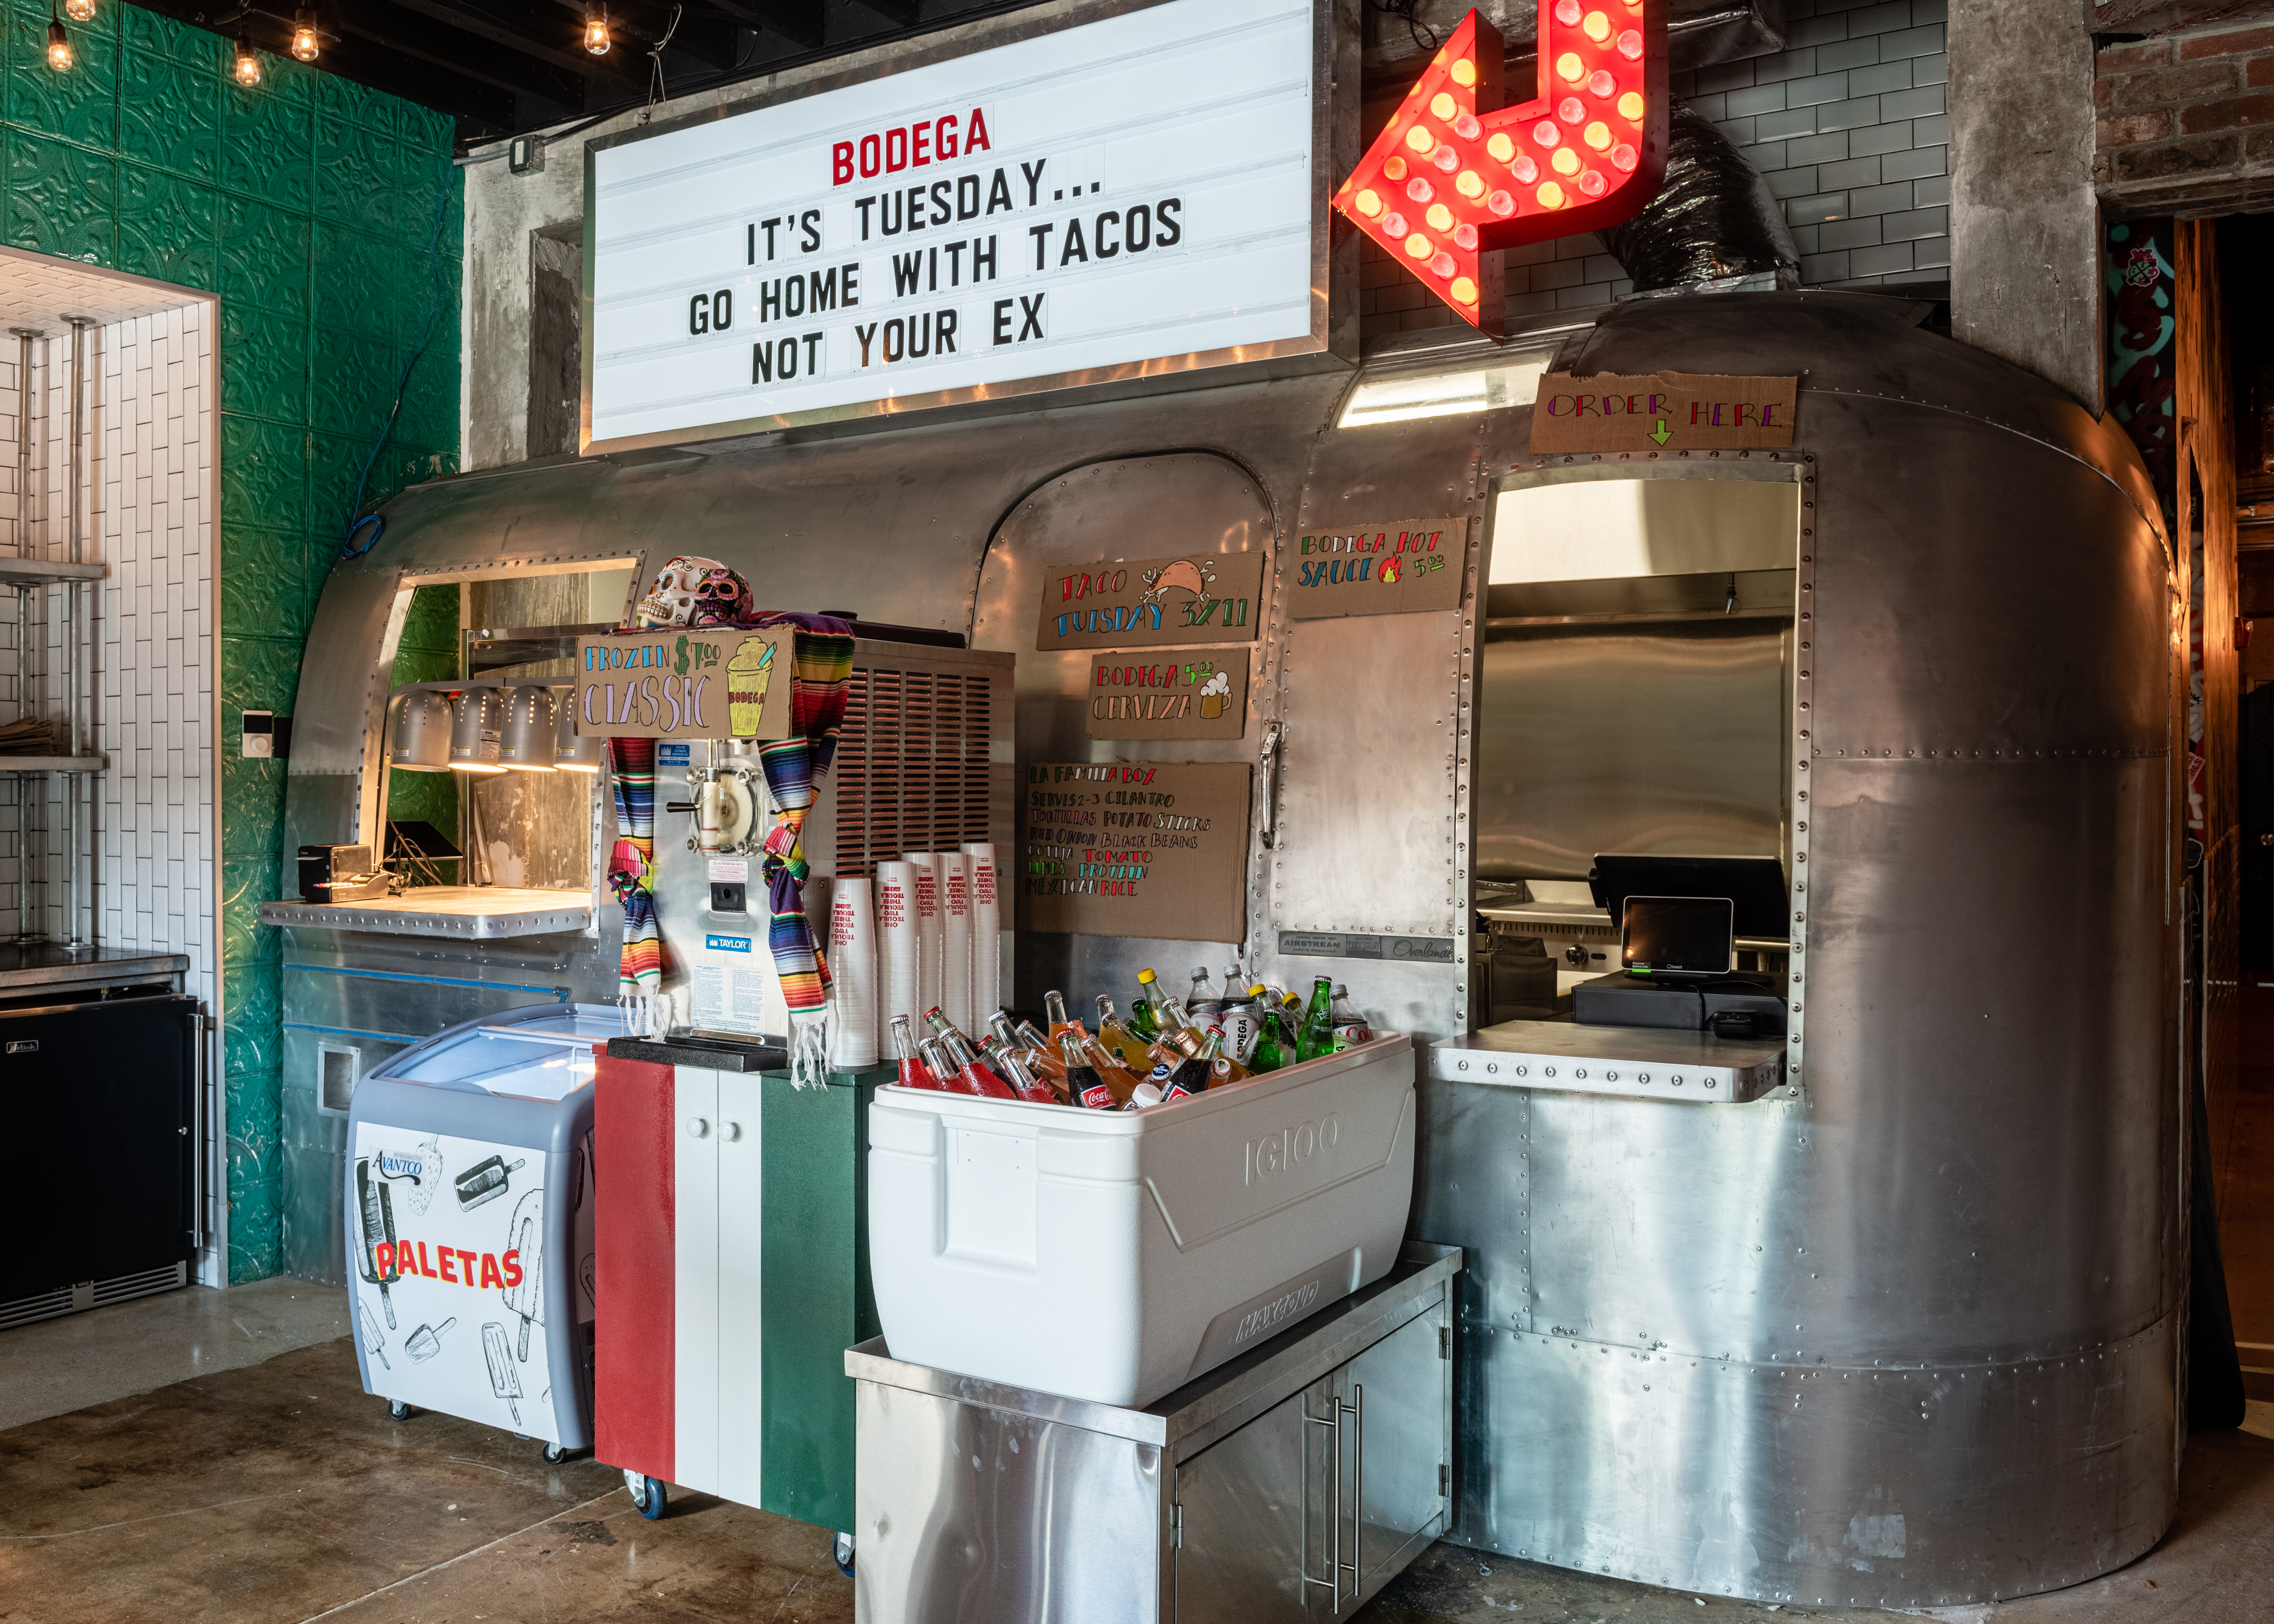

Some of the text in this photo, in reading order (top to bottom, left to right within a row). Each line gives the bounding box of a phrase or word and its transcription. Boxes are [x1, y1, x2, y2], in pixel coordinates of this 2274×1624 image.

[832, 107, 991, 186] BODEGA
[747, 158, 1101, 266] IT'S TUESDAY...
[690, 197, 1182, 336] GO HOME WITH TACOS
[752, 292, 1045, 385] NOT YOUR EX
[1548, 393, 1781, 428] ORDER HERE
[1301, 531, 1443, 554] BODEGA HOT
[1298, 558, 1373, 587] SAUCE
[1057, 570, 1127, 601] TACO
[1052, 603, 1167, 637] TUESDAY
[585, 645, 669, 671] FROZEN
[1097, 665, 1179, 688] BODEGA
[585, 675, 710, 732] CLASSIC
[729, 692, 764, 704] BODEGA
[1093, 694, 1191, 720] CERVEZA
[1030, 766, 1156, 785] LA FAMILIA BOX
[1031, 791, 1174, 807] SERVES 2-3 CILANTRO
[1031, 809, 1211, 831] TORTILLAS POTATO STICKS
[1030, 827, 1197, 849] RED ONION BLACK BEANS
[1028, 844, 1152, 863] COTIJA TOMATO
[1028, 861, 1148, 879] LIMES PROTEIN
[1026, 878, 1137, 896] MEXICAN RICE
[719, 939, 746, 949] TAYLOR
[1394, 940, 1453, 958] Overlande
[372, 1150, 422, 1178] AVANTCO
[393, 1152, 423, 1161] REFRIGERATION
[375, 1240, 523, 1290] PALETAS
